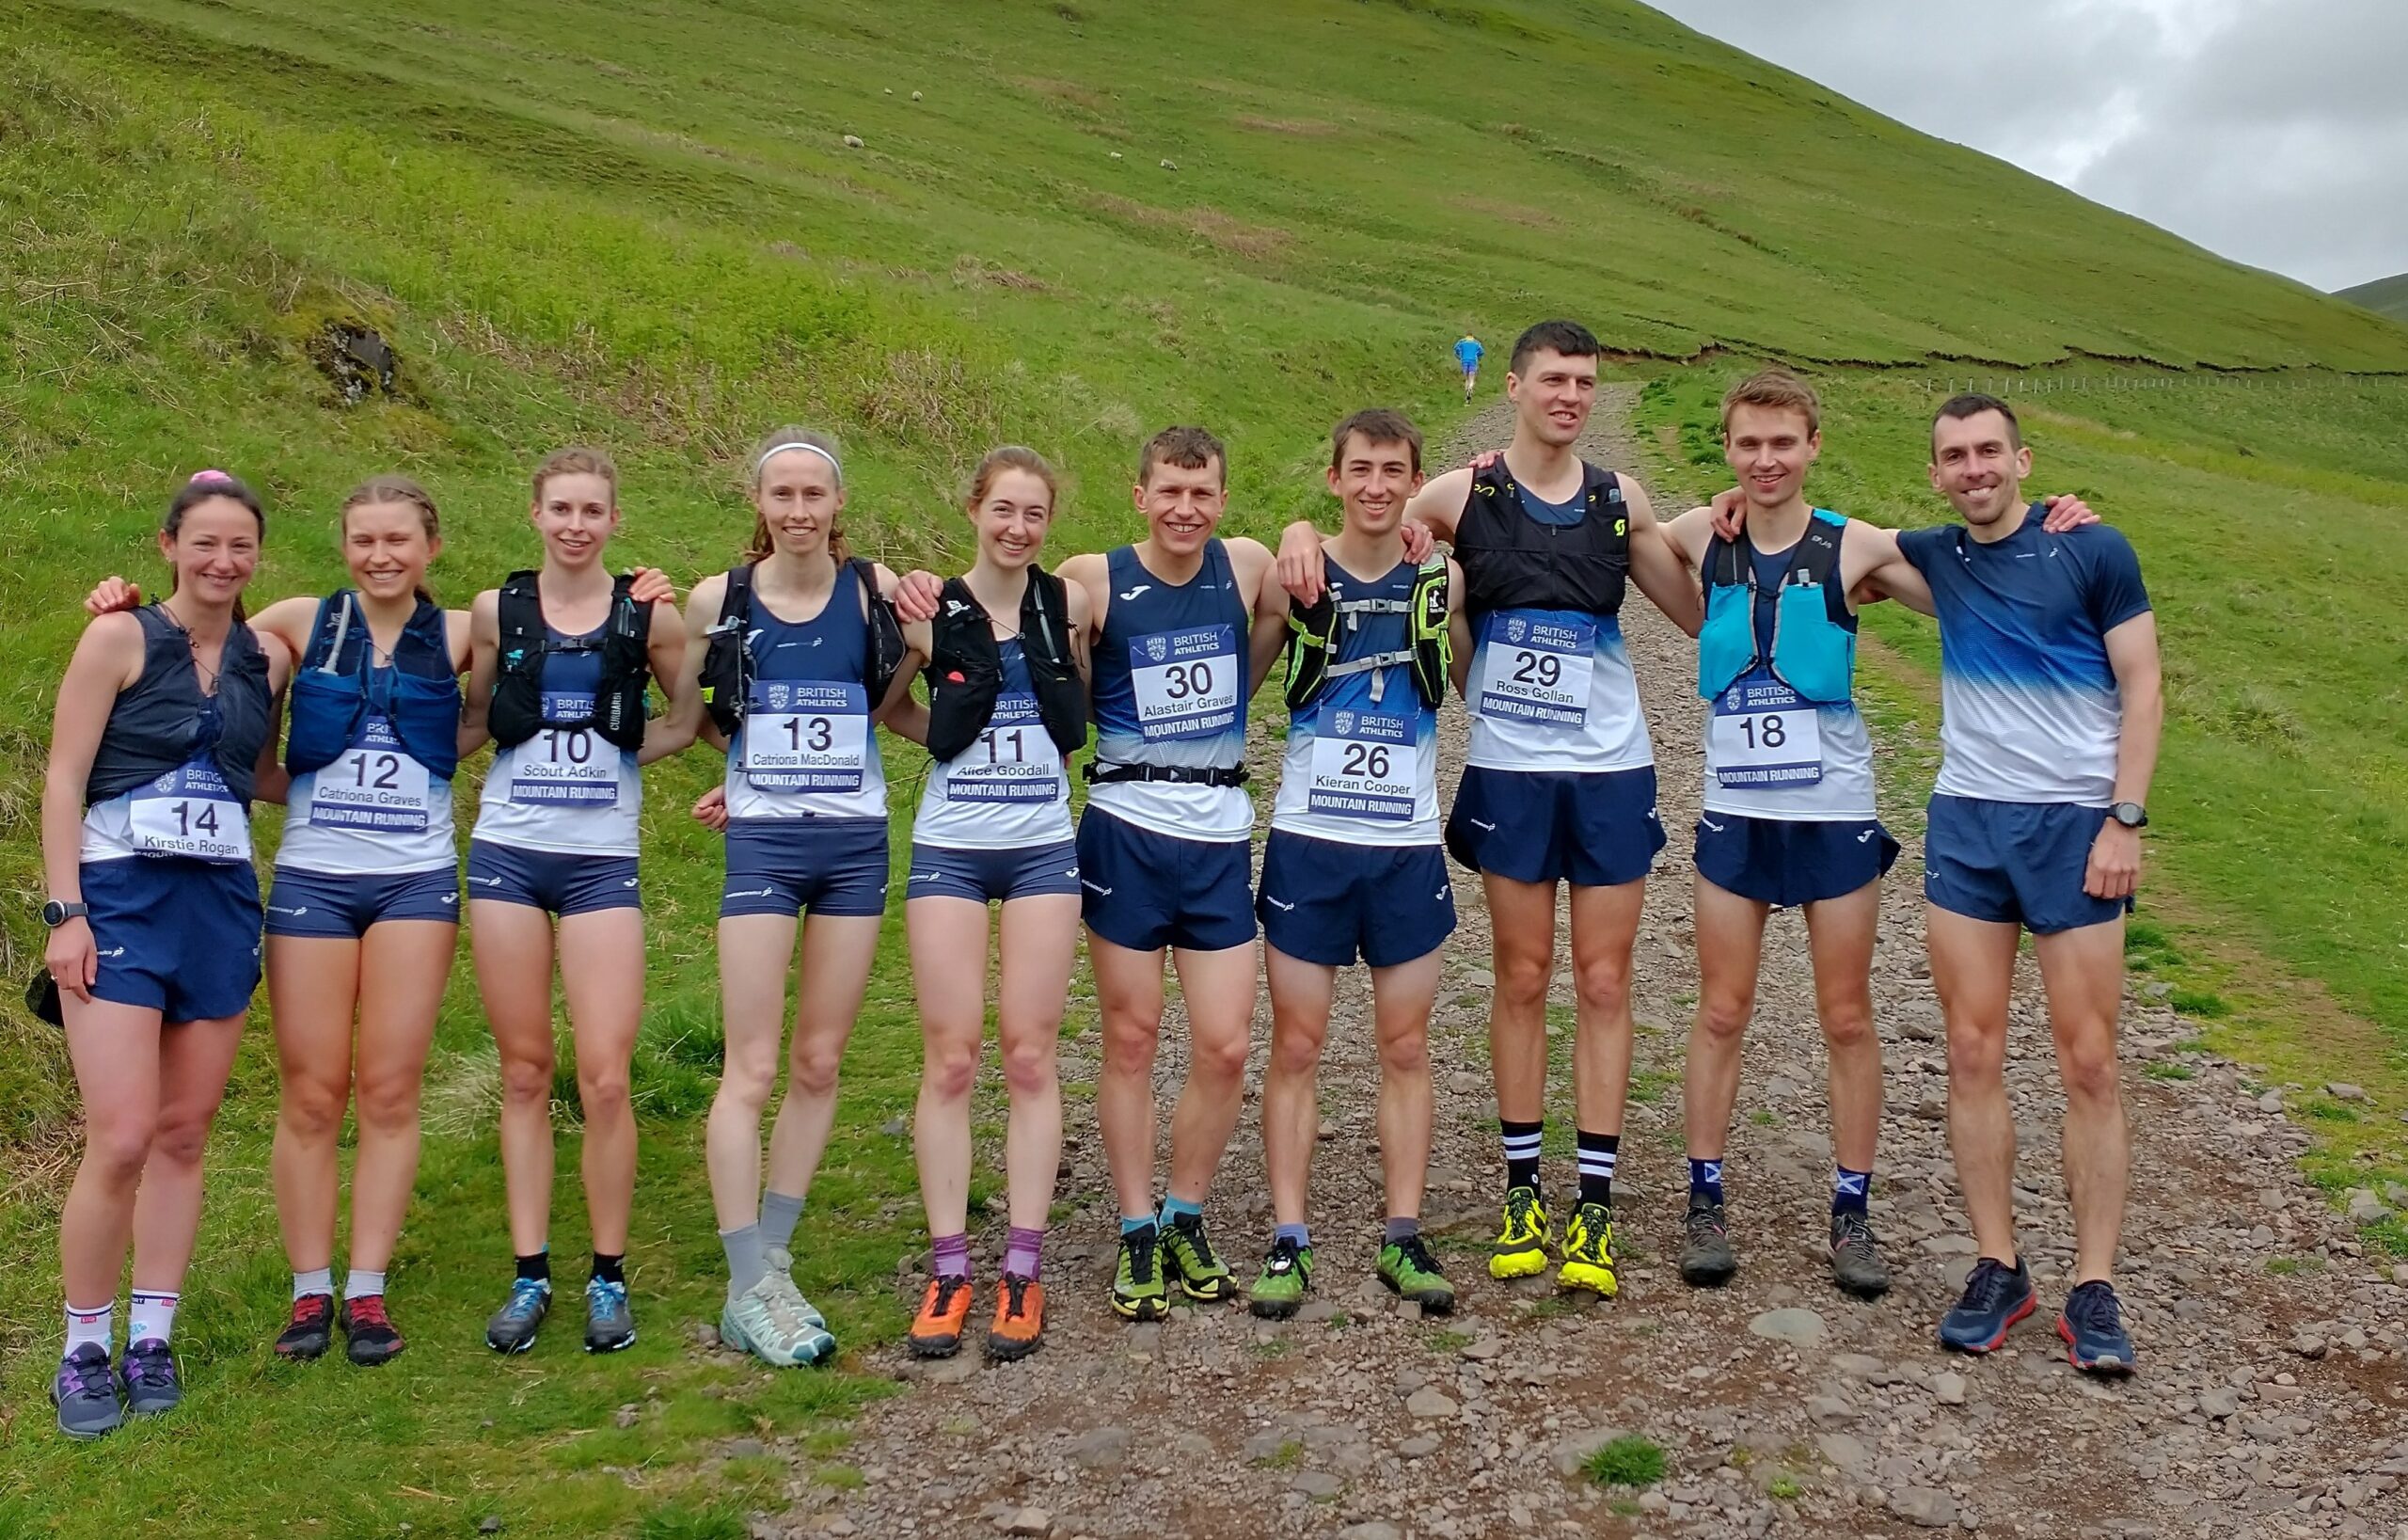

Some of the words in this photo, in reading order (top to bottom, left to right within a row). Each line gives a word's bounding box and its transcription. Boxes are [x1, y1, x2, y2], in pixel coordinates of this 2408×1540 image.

[1173, 631, 1218, 646] BRITISH
[1530, 636, 1576, 649] ATHLETICS
[1532, 625, 1577, 641] BRITISH
[1174, 643, 1220, 656] ATHLETICS
[1513, 651, 1561, 688] 29
[1164, 661, 1213, 699] 30
[798, 688, 847, 698] BRITISH
[1496, 680, 1529, 696] Ross
[1531, 688, 1574, 704] Gollan
[1747, 696, 1797, 706] ATHLETICS
[796, 699, 848, 707] ATHLETICS
[1144, 700, 1194, 718] Alastair
[1196, 694, 1233, 709] Graves
[1482, 696, 1535, 717] MOUNTAIN
[1536, 707, 1582, 724] RUNNING
[1144, 719, 1200, 738] MOUNTAIN
[1201, 711, 1234, 729] RUNNING
[1358, 726, 1403, 738] ATHLETICS
[1361, 715, 1403, 729] BRITISH
[1739, 715, 1785, 749] 18
[784, 717, 832, 752] 13
[544, 729, 593, 764] 10
[980, 729, 1023, 764] 11
[752, 754, 798, 766] Catriona
[800, 754, 860, 766] MacDonald
[957, 766, 992, 776] Alice
[996, 764, 1050, 776] Goodall
[1341, 742, 1390, 779] 26
[350, 753, 400, 790] 12
[523, 765, 563, 777] Scout
[568, 766, 607, 779] Adkin
[749, 773, 809, 786] MOUNTAIN
[811, 774, 860, 786] RUNNING
[1719, 770, 1768, 784] MOUNTAIN
[1769, 767, 1819, 781] RUNNING
[513, 785, 567, 799] MOUNTAIN
[570, 786, 615, 799] RUNNING
[949, 784, 1006, 797] MOUNTAIN
[1008, 784, 1056, 797] RUNNING
[1315, 774, 1360, 790] Kieran
[1364, 780, 1411, 795] Cooper
[319, 786, 373, 803] Catriona
[378, 791, 421, 806] Graves
[1310, 794, 1367, 811] MOUNTAIN
[1368, 800, 1411, 815] RUNNING
[171, 801, 218, 837] 14
[312, 807, 372, 823] MOUNTAIN
[374, 813, 425, 827] RUNNING
[145, 835, 195, 850] Kirstie
[199, 839, 239, 856] Rogan
